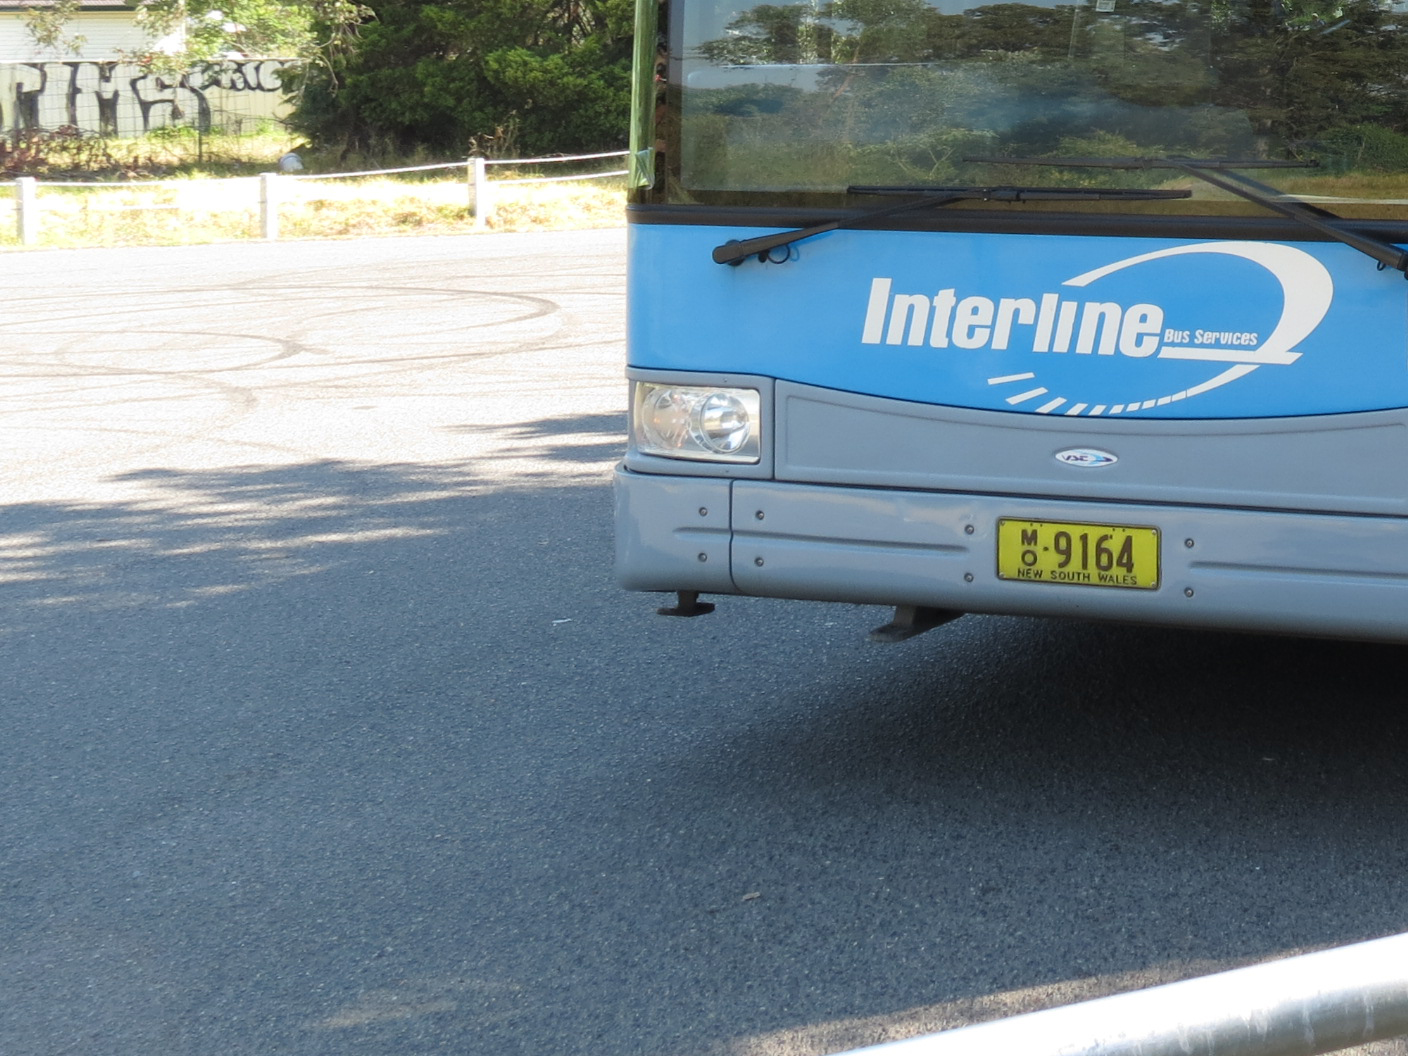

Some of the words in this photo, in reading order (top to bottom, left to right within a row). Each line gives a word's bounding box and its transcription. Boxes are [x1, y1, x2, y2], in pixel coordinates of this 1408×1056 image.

[861, 277, 1165, 359] Interline
[1163, 328, 1191, 344] Bus
[1194, 329, 1259, 346] Services
[1053, 531, 1134, 573] 9164
[1017, 568, 1043, 579] NEW
[1050, 570, 1091, 582] SOUTH
[1098, 573, 1137, 585] WALES
